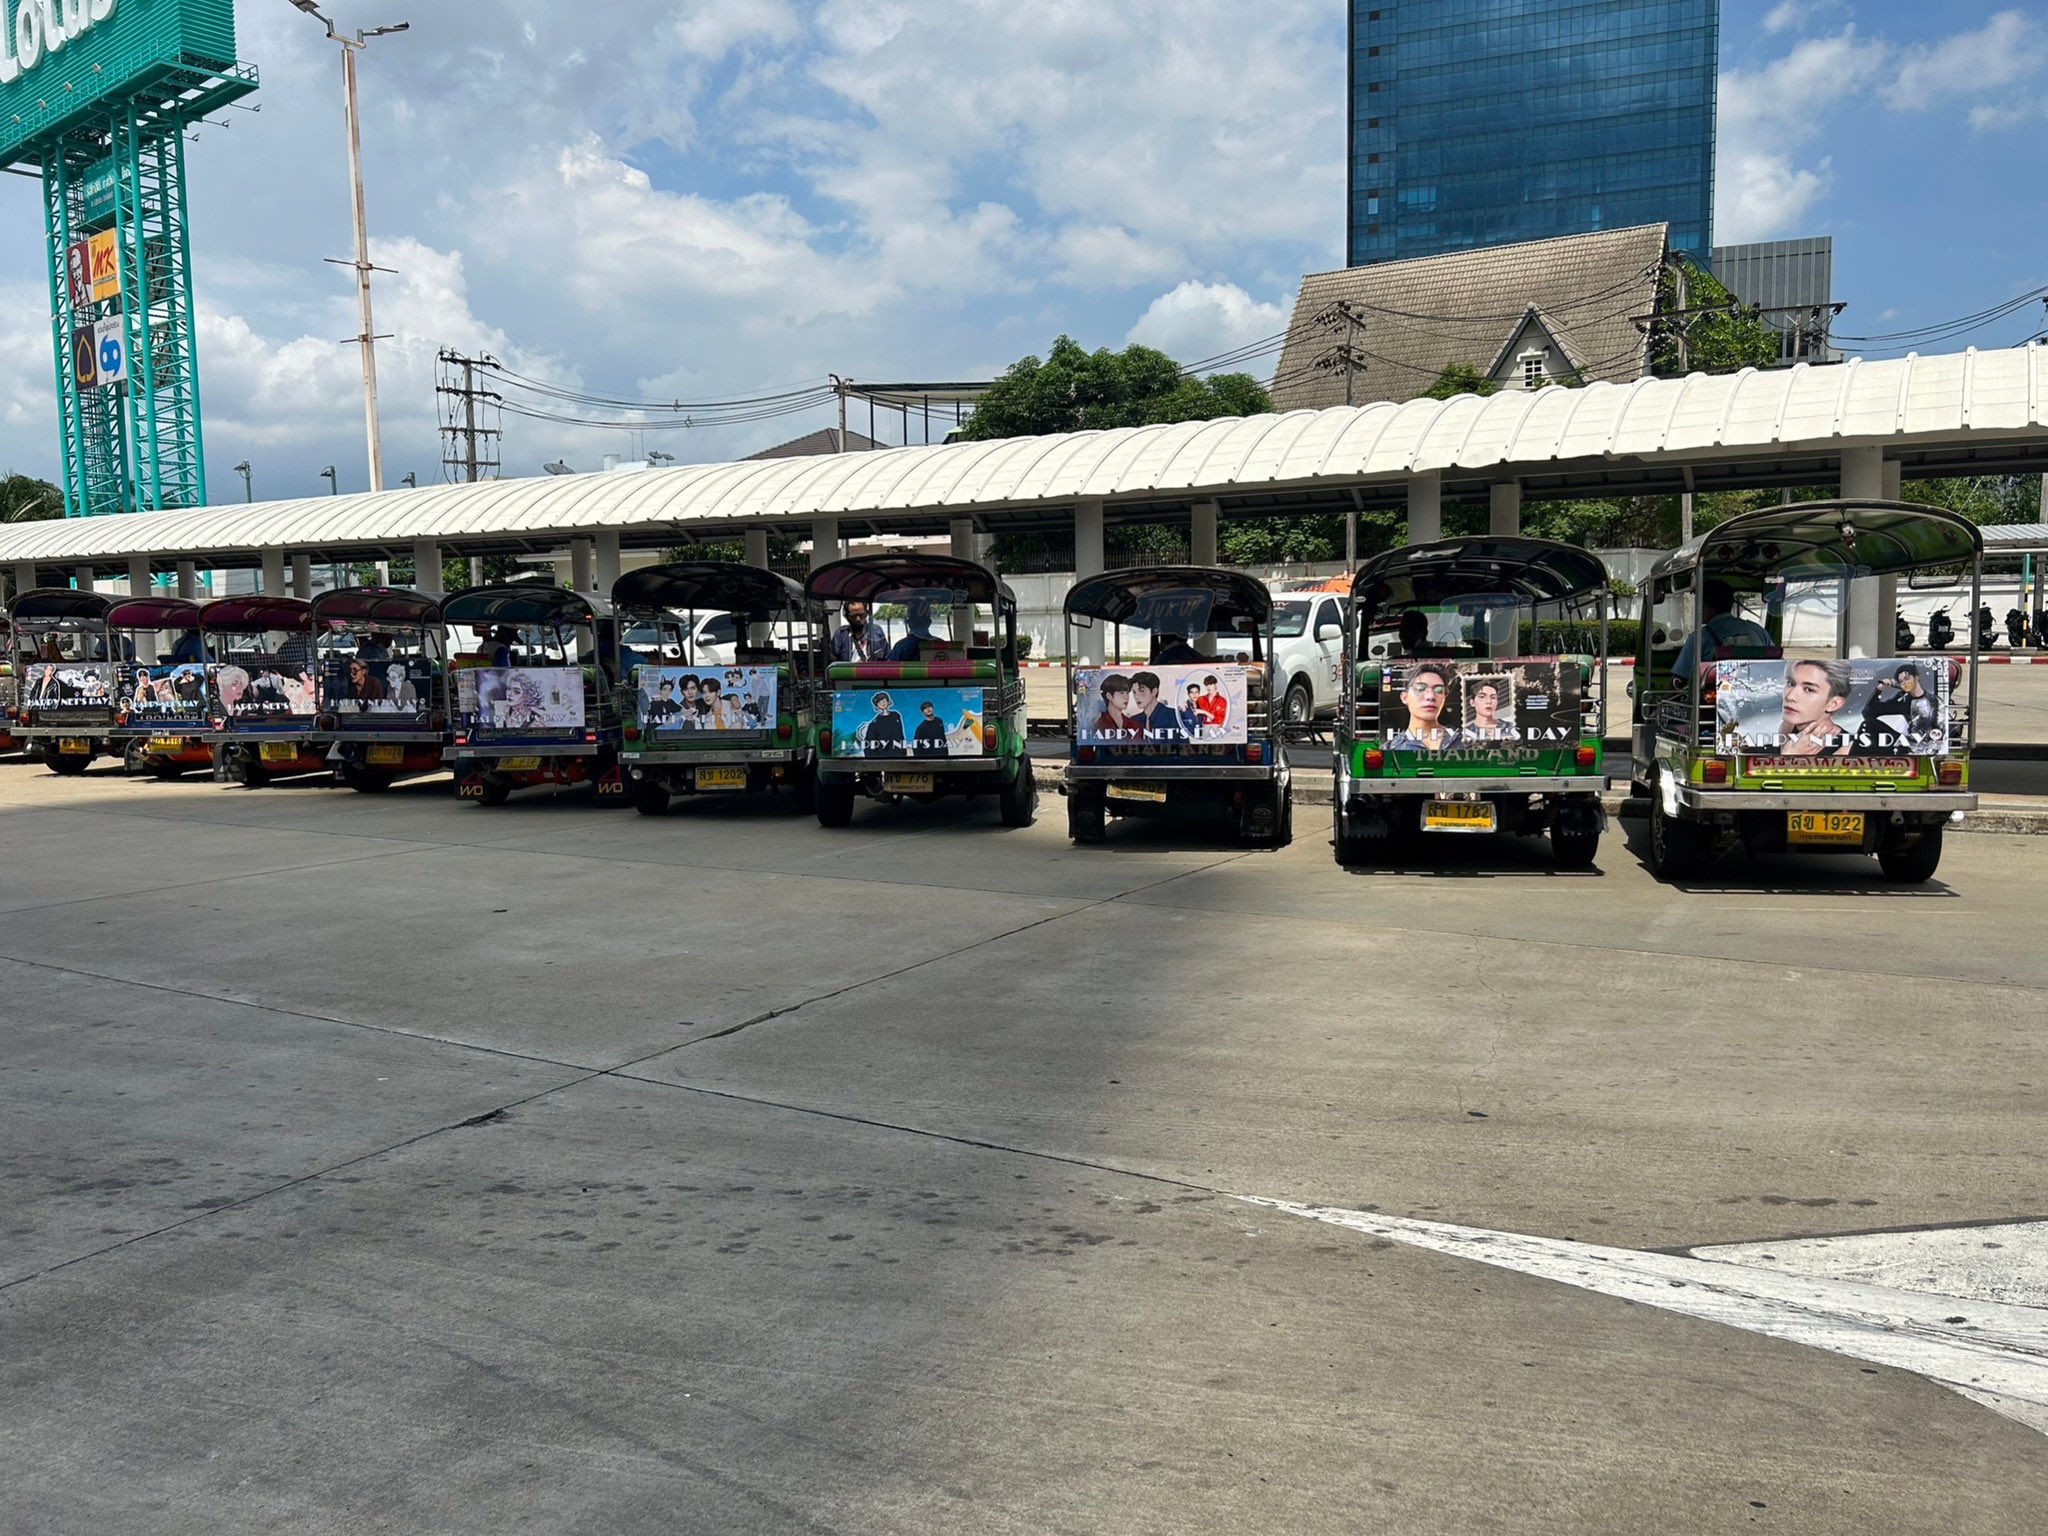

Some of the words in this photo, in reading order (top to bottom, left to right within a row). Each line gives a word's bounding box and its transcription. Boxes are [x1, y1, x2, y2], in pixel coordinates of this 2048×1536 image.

[93, 245, 115, 277] MK
[1081, 728, 1140, 740] HAPPY
[1143, 728, 1188, 739] NET'S
[1386, 727, 1461, 741] HAPPY
[1464, 727, 1521, 741] NET'S
[1527, 727, 1572, 740] DAY
[1724, 733, 1801, 747] HAPPY
[1809, 733, 1873, 747] NET'S
[1878, 733, 1927, 747] DAY
[1413, 749, 1540, 762] THAILAND
[719, 767, 742, 780] 1202
[1456, 804, 1489, 818] 1782
[1791, 814, 1815, 831] สข
[1822, 813, 1862, 831] 1922
